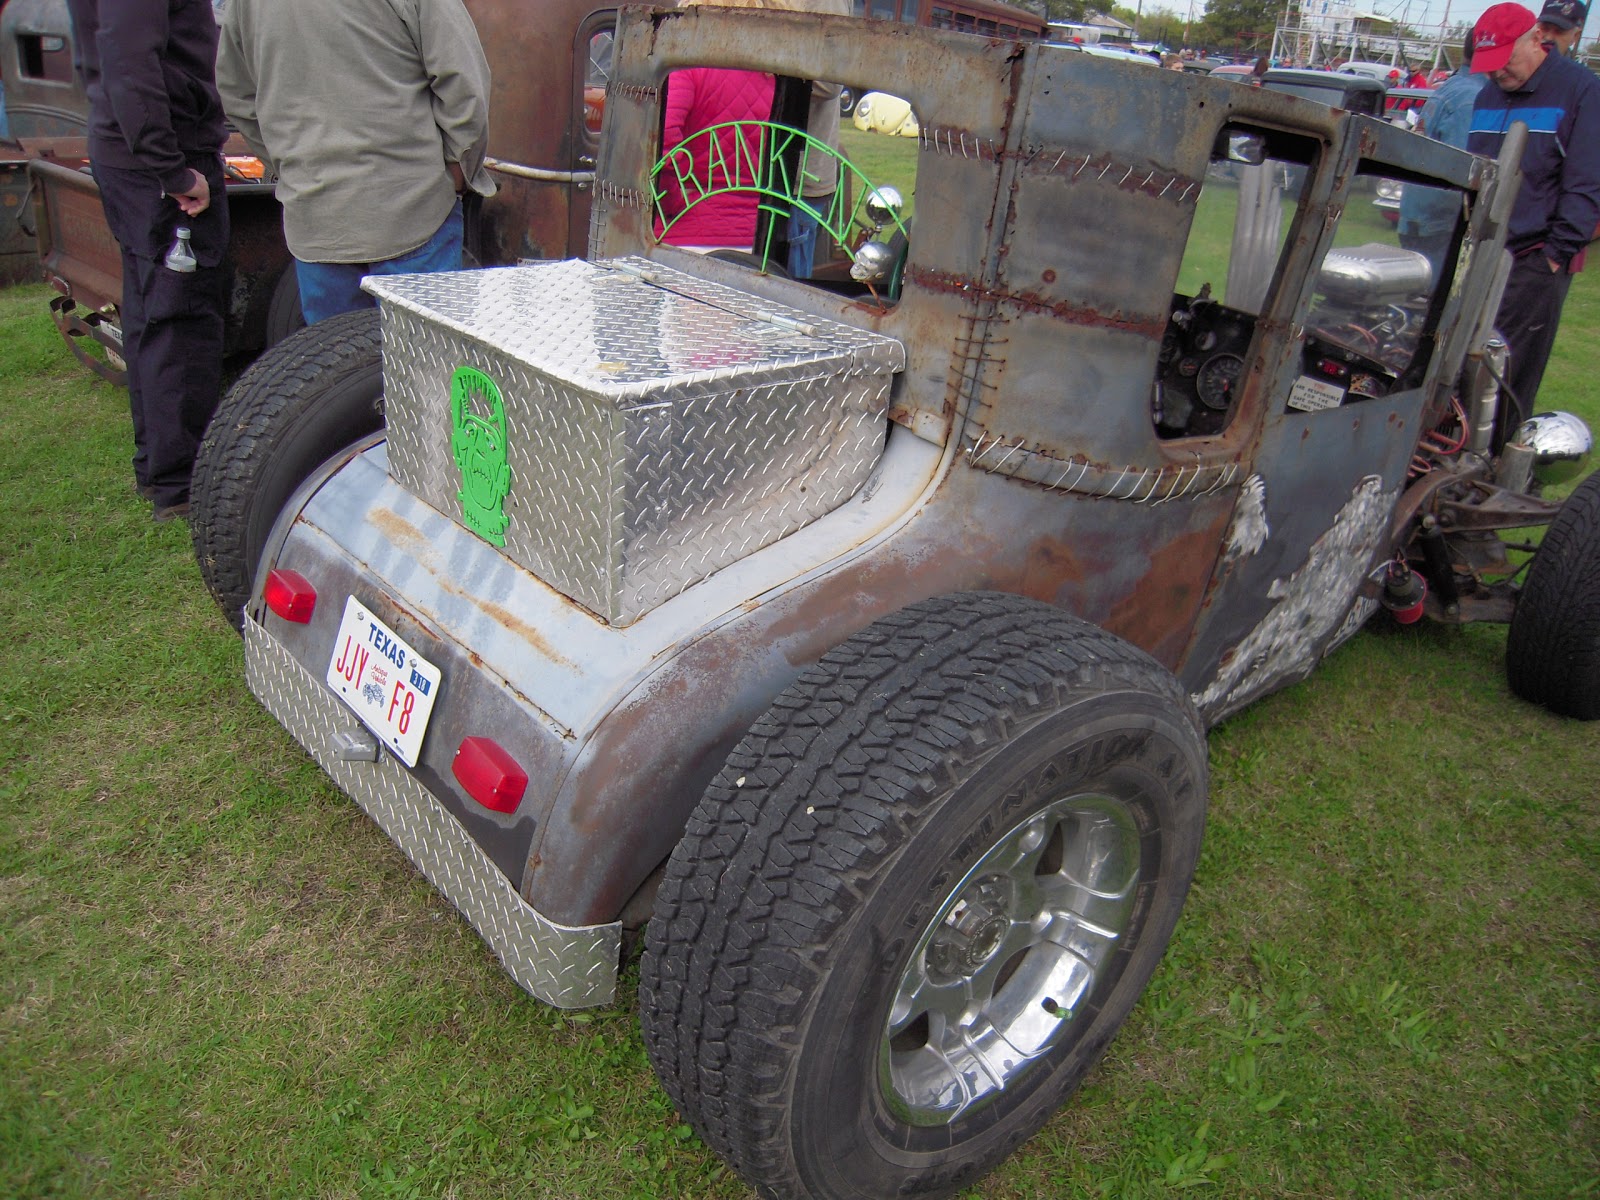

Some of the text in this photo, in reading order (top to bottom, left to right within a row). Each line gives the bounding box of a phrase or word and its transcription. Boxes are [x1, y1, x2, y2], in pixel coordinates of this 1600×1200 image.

[1303, 392, 1315, 400] FOR
[1307, 388, 1340, 402] RESPONSIBLE
[368, 622, 406, 669] TEXAS
[336, 635, 415, 735] JJY F8
